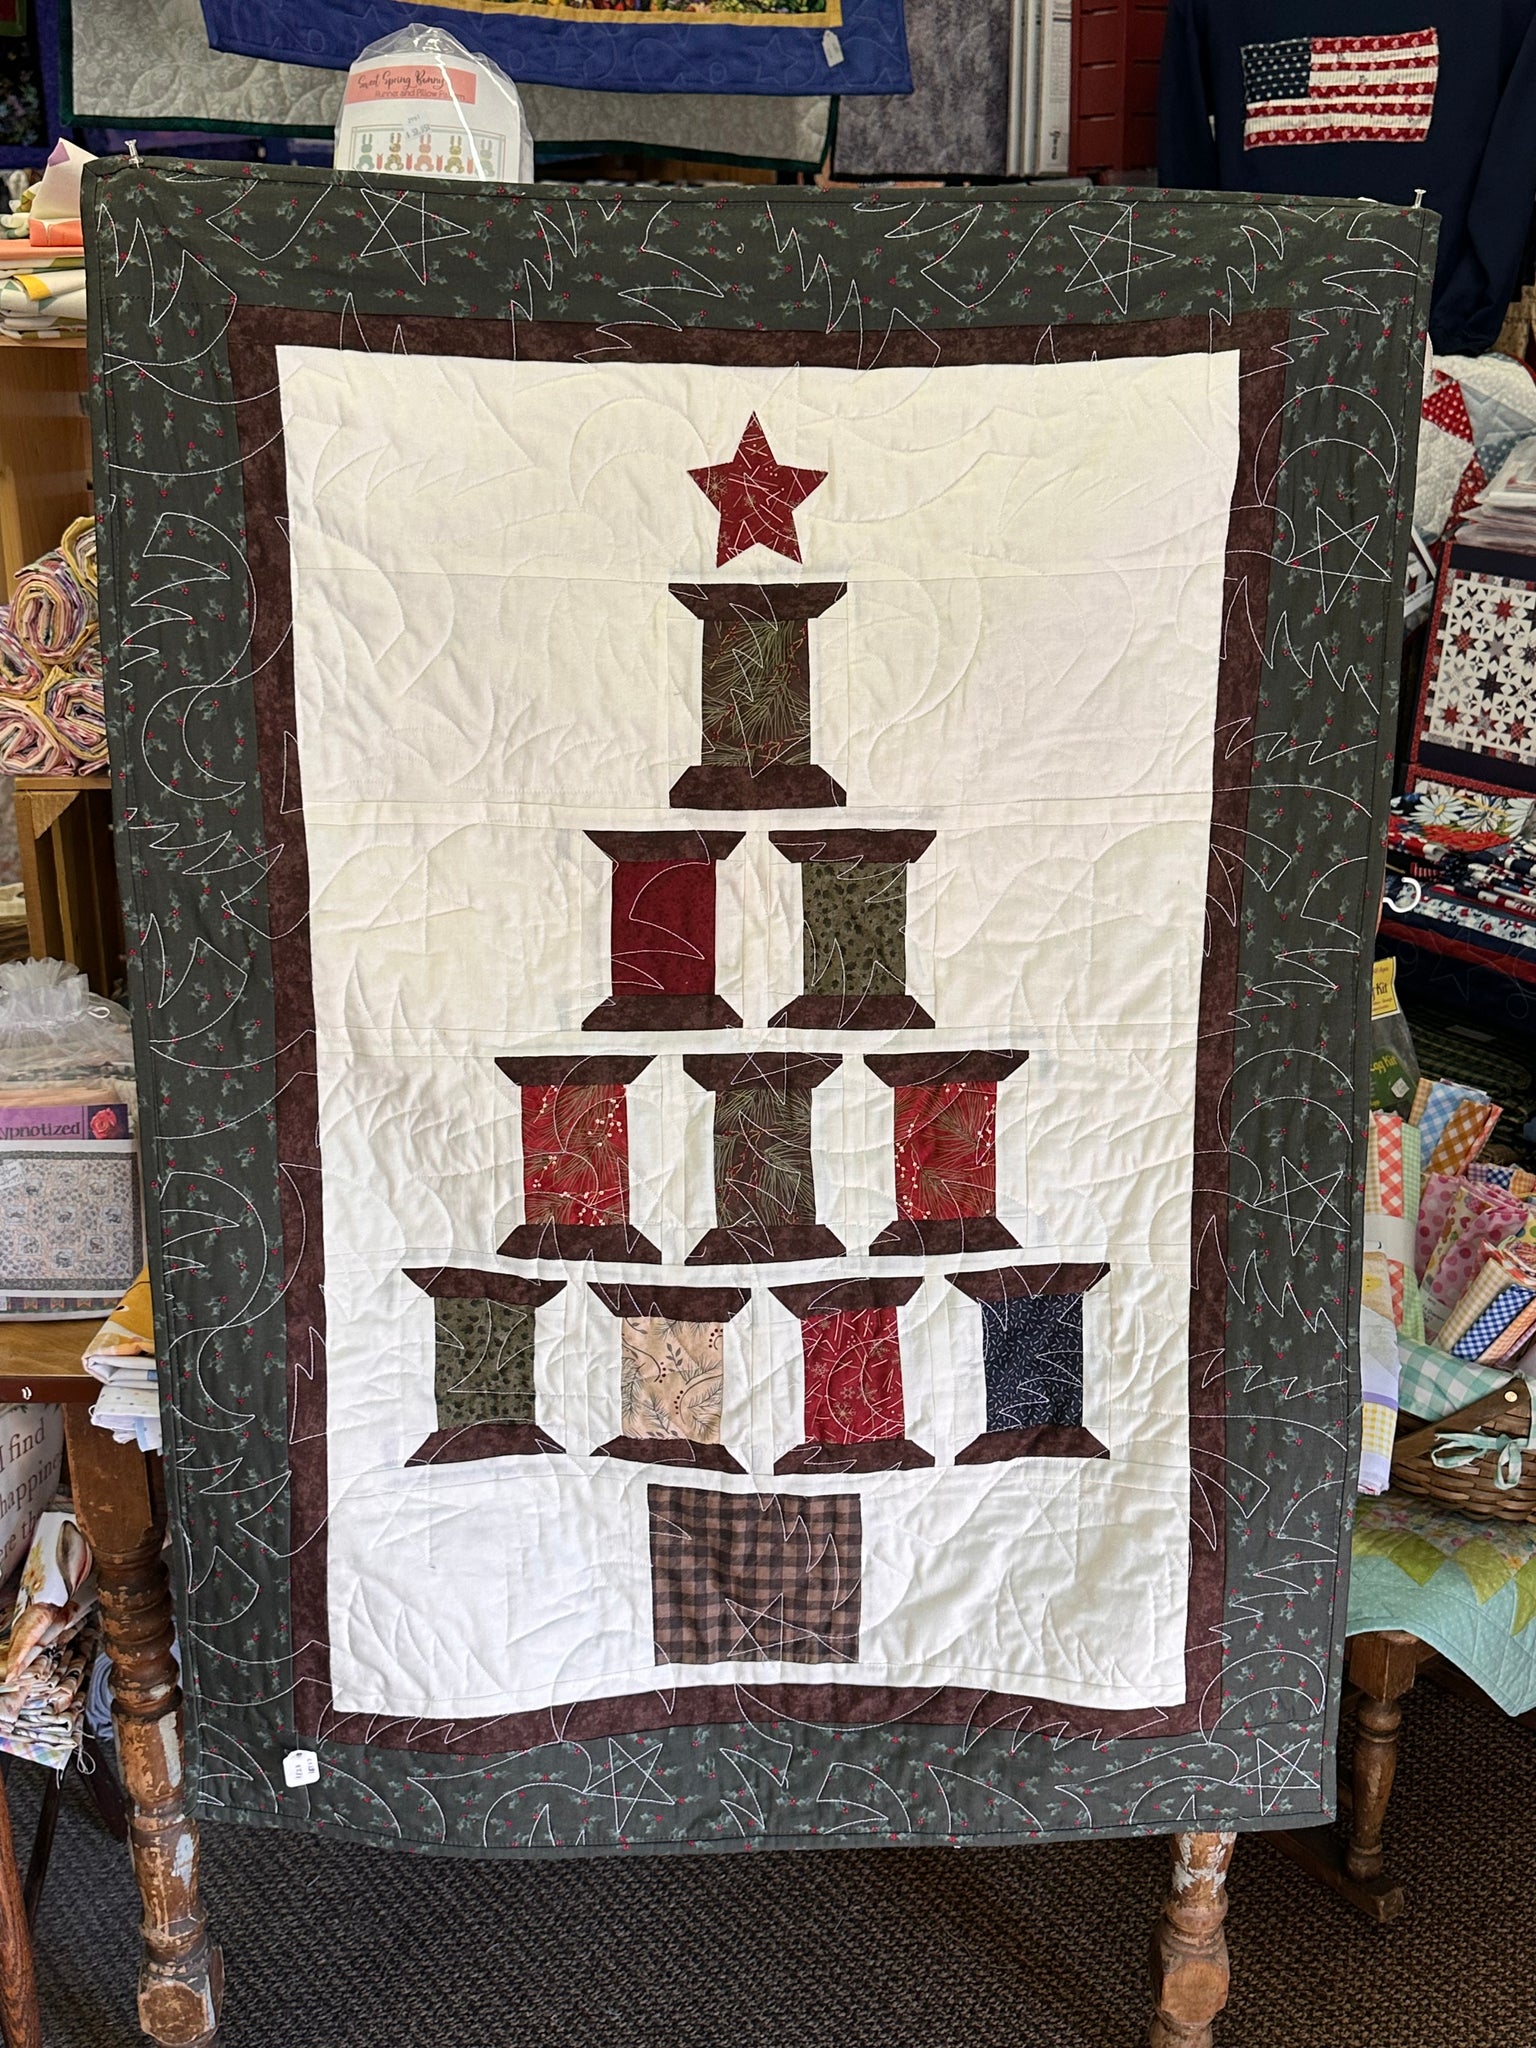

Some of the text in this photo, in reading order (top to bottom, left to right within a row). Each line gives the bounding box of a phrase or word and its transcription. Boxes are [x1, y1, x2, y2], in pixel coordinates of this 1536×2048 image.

[383, 70, 417, 90] Spring
[415, 69, 445, 89] Bunny
[399, 89, 415, 97] and
[416, 89, 437, 97] Pillow
[9, 1417, 45, 1463] find
